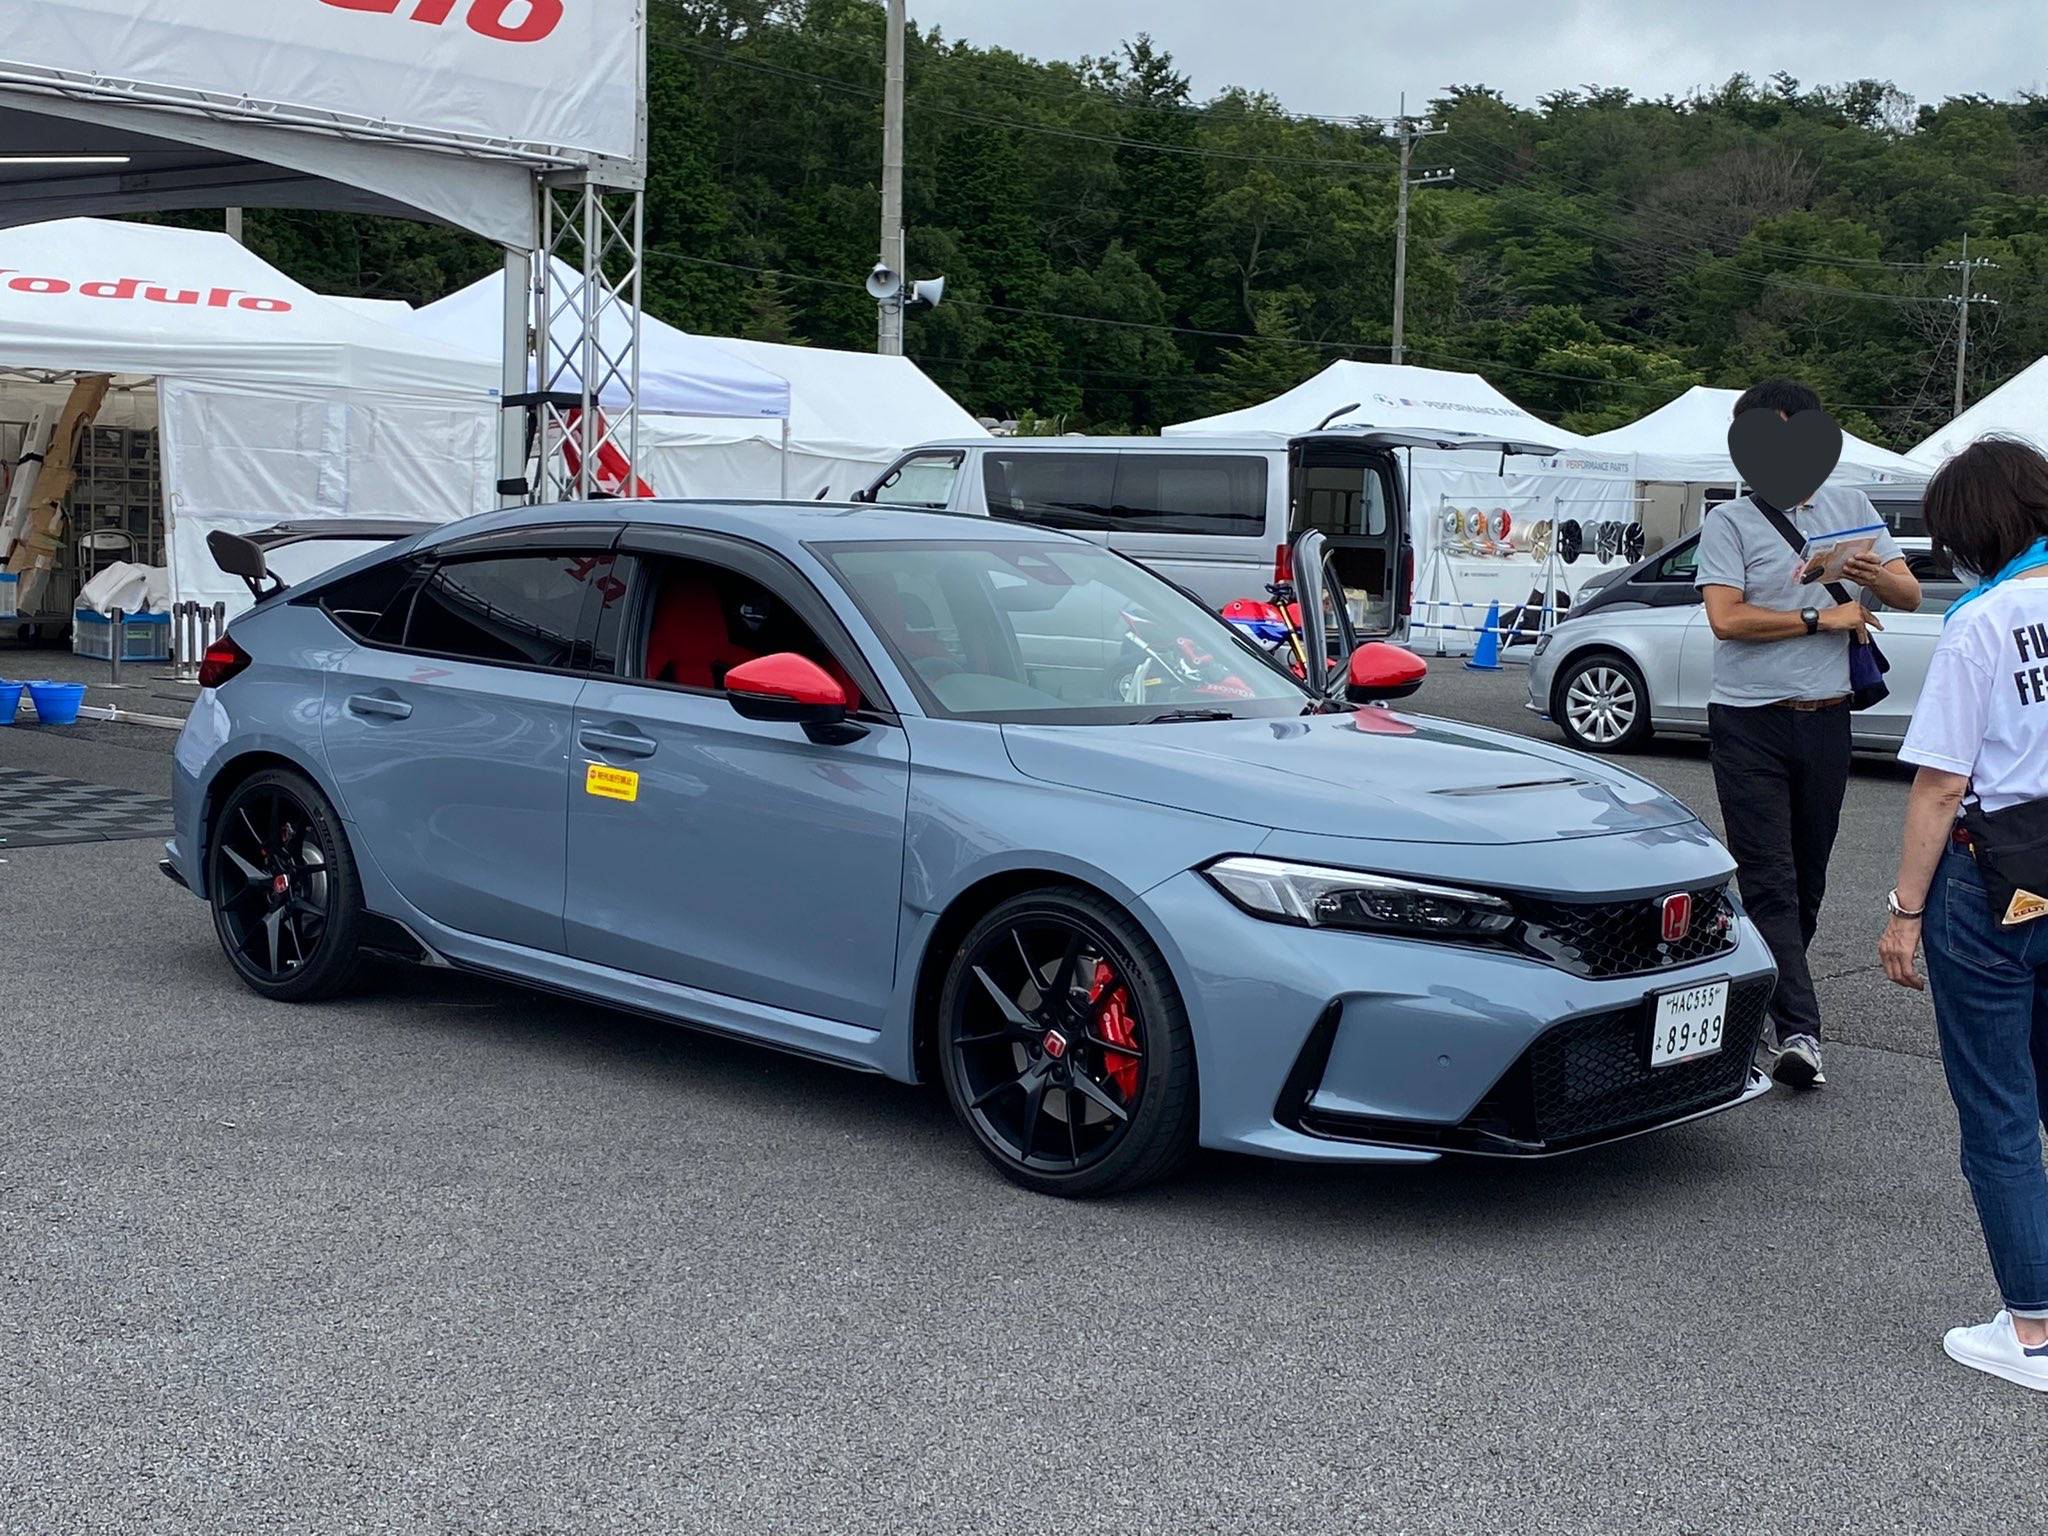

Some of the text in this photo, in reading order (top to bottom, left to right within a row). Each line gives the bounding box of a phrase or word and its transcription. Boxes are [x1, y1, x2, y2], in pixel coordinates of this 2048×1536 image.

[0, 269, 292, 312] odulo
[1566, 459, 1609, 471] PERFORMANCE
[2012, 622, 2048, 663] FU
[1670, 987, 1714, 1015] HAC555
